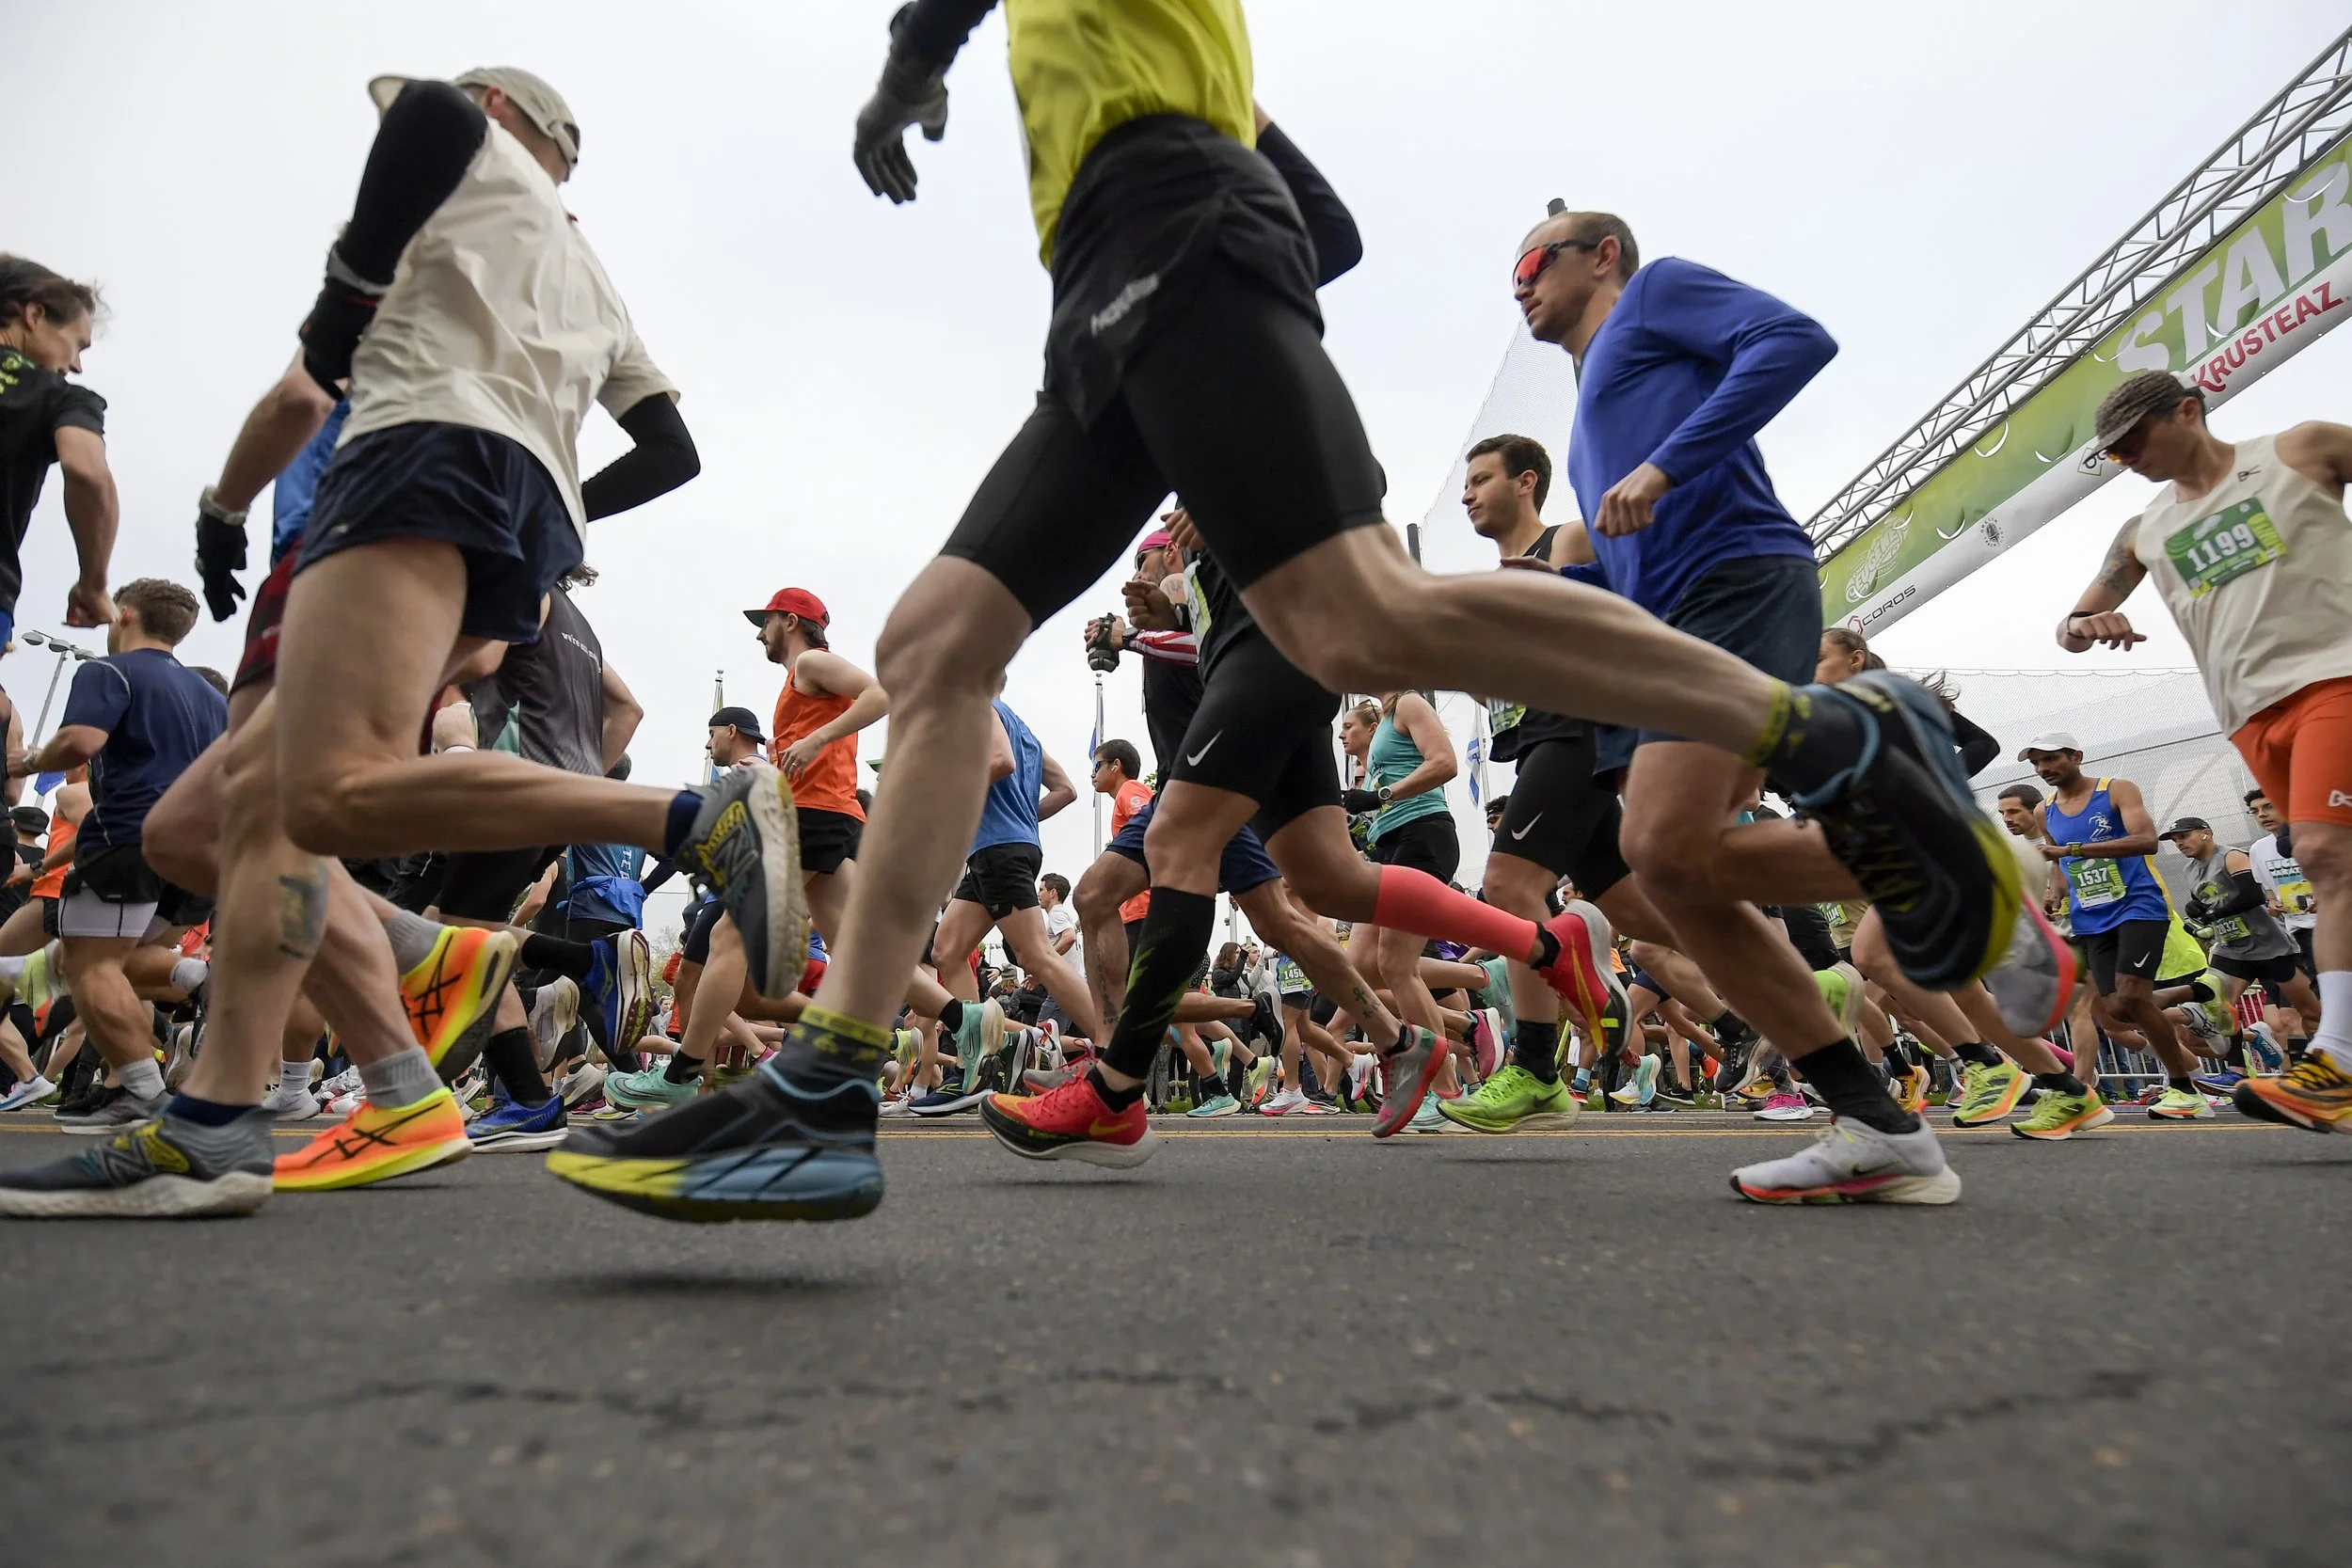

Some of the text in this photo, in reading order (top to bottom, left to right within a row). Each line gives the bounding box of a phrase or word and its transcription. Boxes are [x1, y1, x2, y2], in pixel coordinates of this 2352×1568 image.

[2190, 281, 2344, 392] KRUSTEAZ
[2187, 523, 2255, 573] 1199
[1862, 584, 1916, 626] COROS
[2077, 867, 2108, 887] 1537
